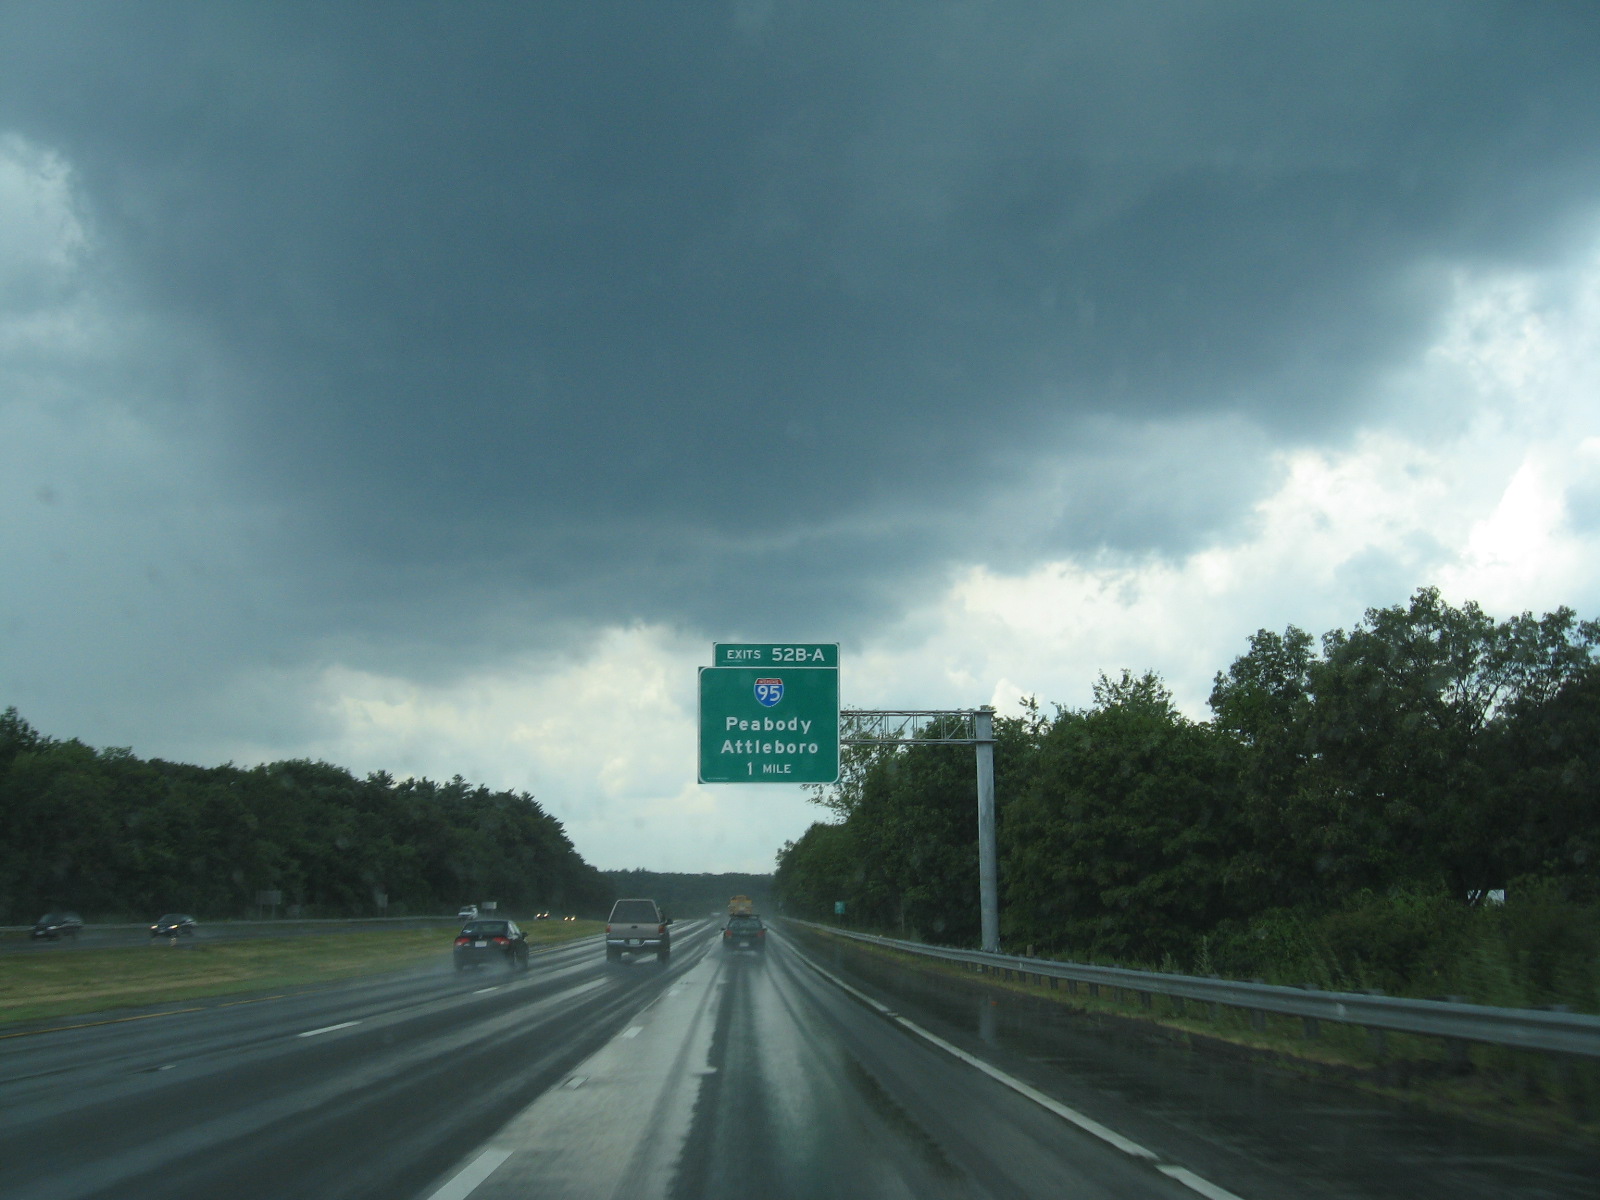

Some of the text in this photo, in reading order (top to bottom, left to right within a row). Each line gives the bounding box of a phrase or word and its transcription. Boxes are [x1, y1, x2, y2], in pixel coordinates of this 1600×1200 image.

[727, 648, 825, 661] EXITS 52B-A
[757, 685, 781, 702] 95
[725, 716, 812, 735] Peabody
[720, 739, 819, 754] Attleboro
[747, 761, 792, 776] 1 MILE
